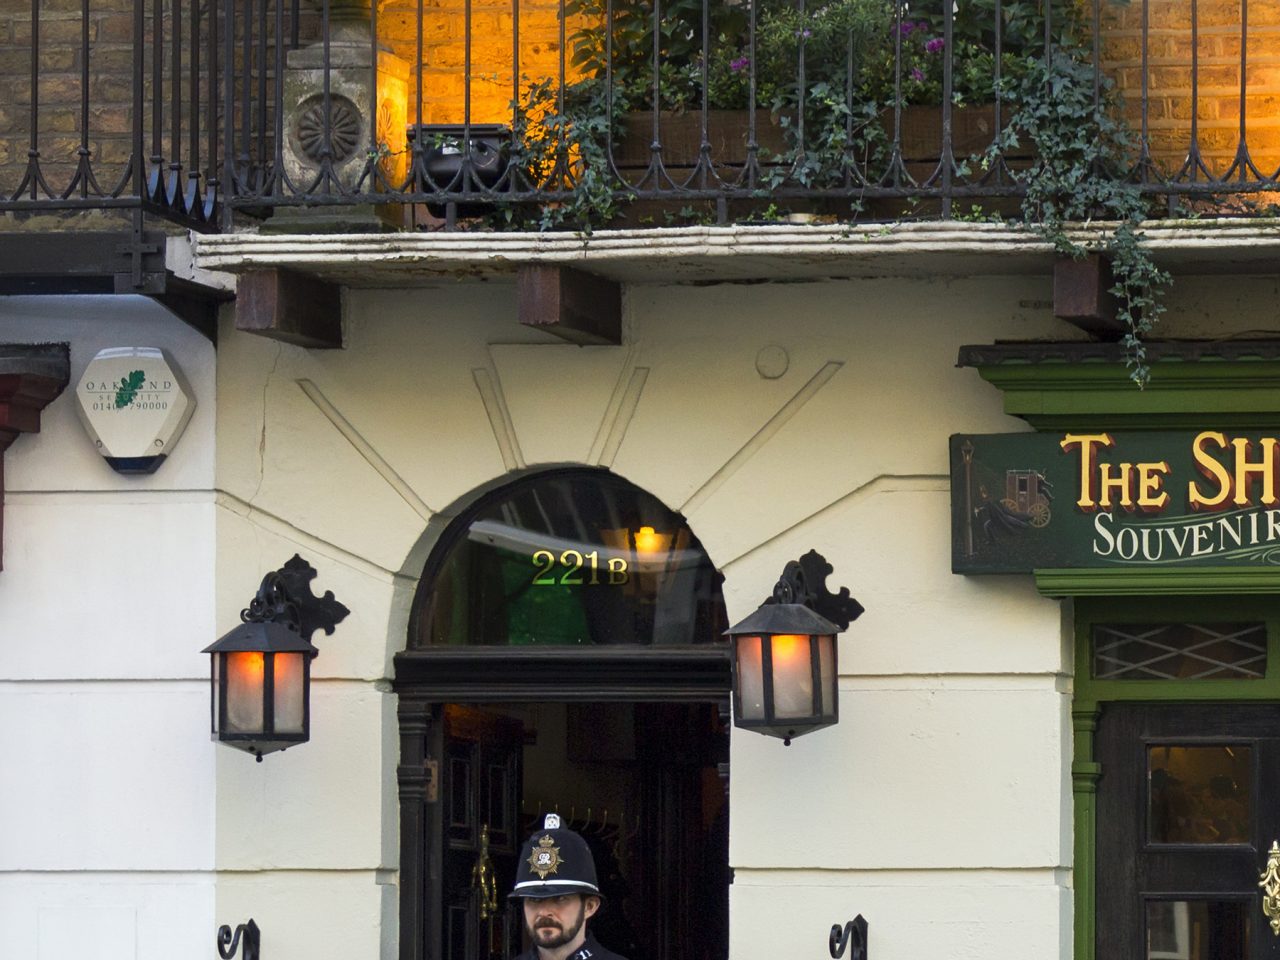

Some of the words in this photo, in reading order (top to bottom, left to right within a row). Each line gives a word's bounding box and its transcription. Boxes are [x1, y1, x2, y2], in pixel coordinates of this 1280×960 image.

[86, 381, 172, 391] OAKND
[1060, 432, 1169, 509] THE
[532, 550, 630, 585] 221B
